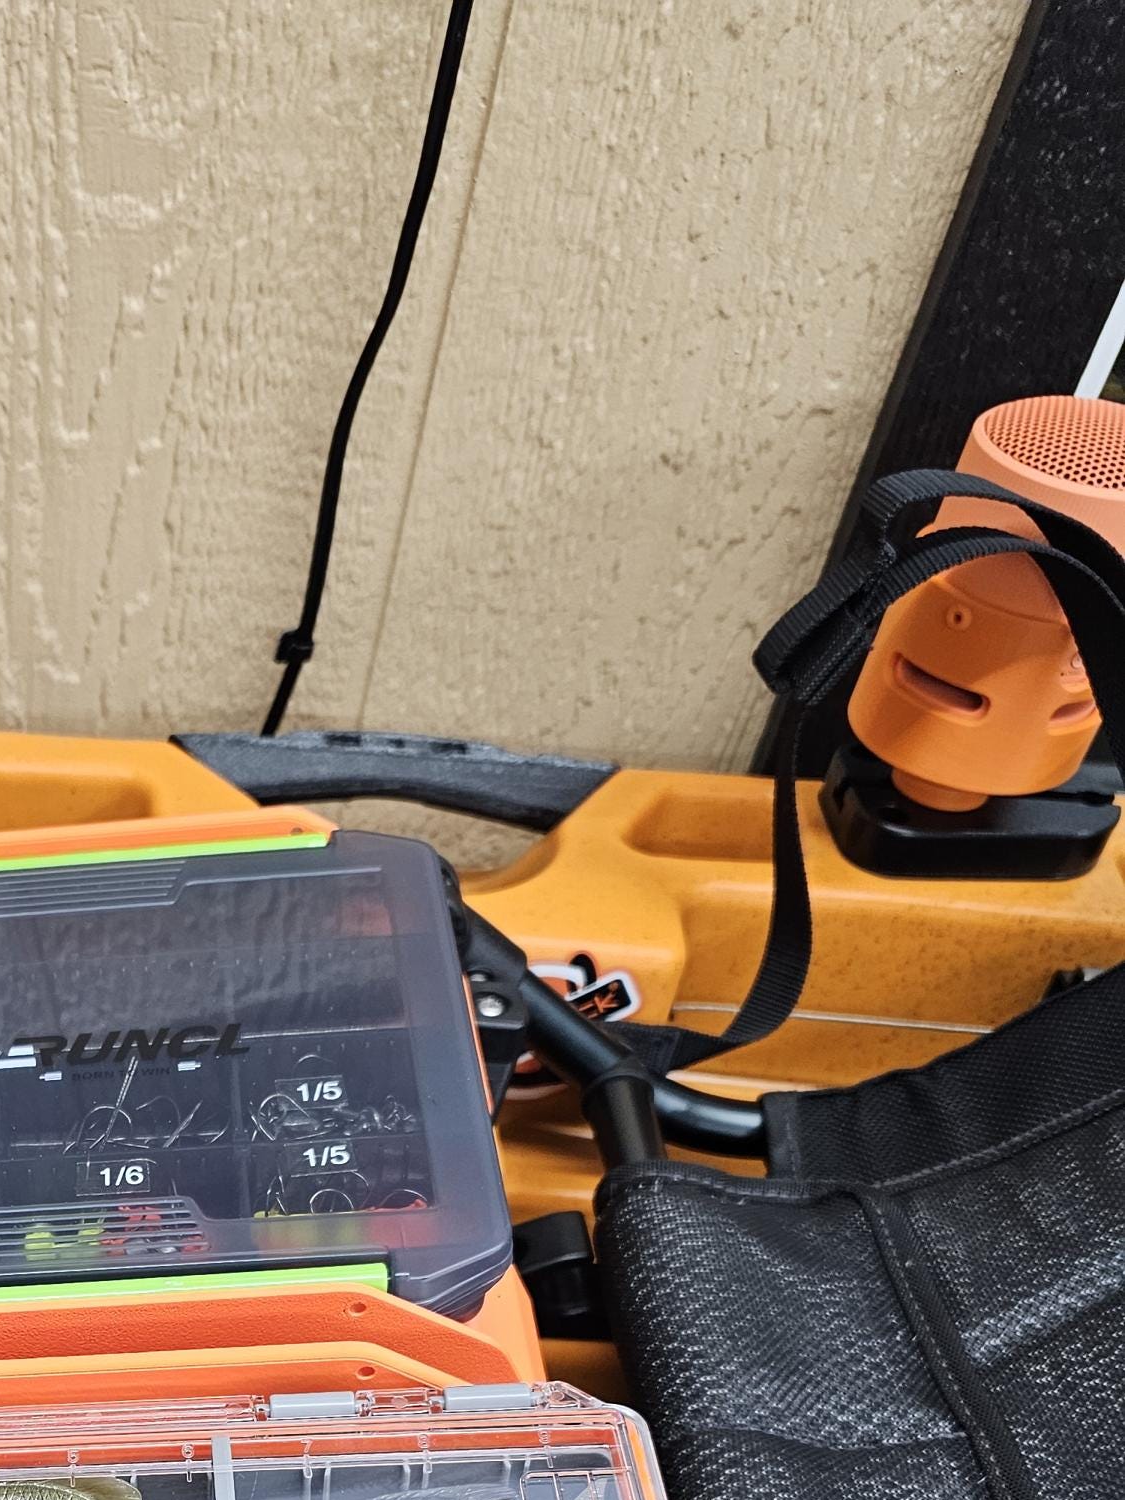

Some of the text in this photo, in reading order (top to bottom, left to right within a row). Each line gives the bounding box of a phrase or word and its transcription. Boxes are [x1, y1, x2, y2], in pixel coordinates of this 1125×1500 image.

[12, 1023, 250, 1067] RUNCL
[141, 1066, 171, 1077] WIN
[296, 1080, 343, 1102] 1/5
[302, 1144, 351, 1167] 1/5
[99, 1165, 145, 1187] 1/6
[66, 1448, 79, 1464] 5
[181, 1442, 195, 1459] 6
[300, 1438, 313, 1454] 7
